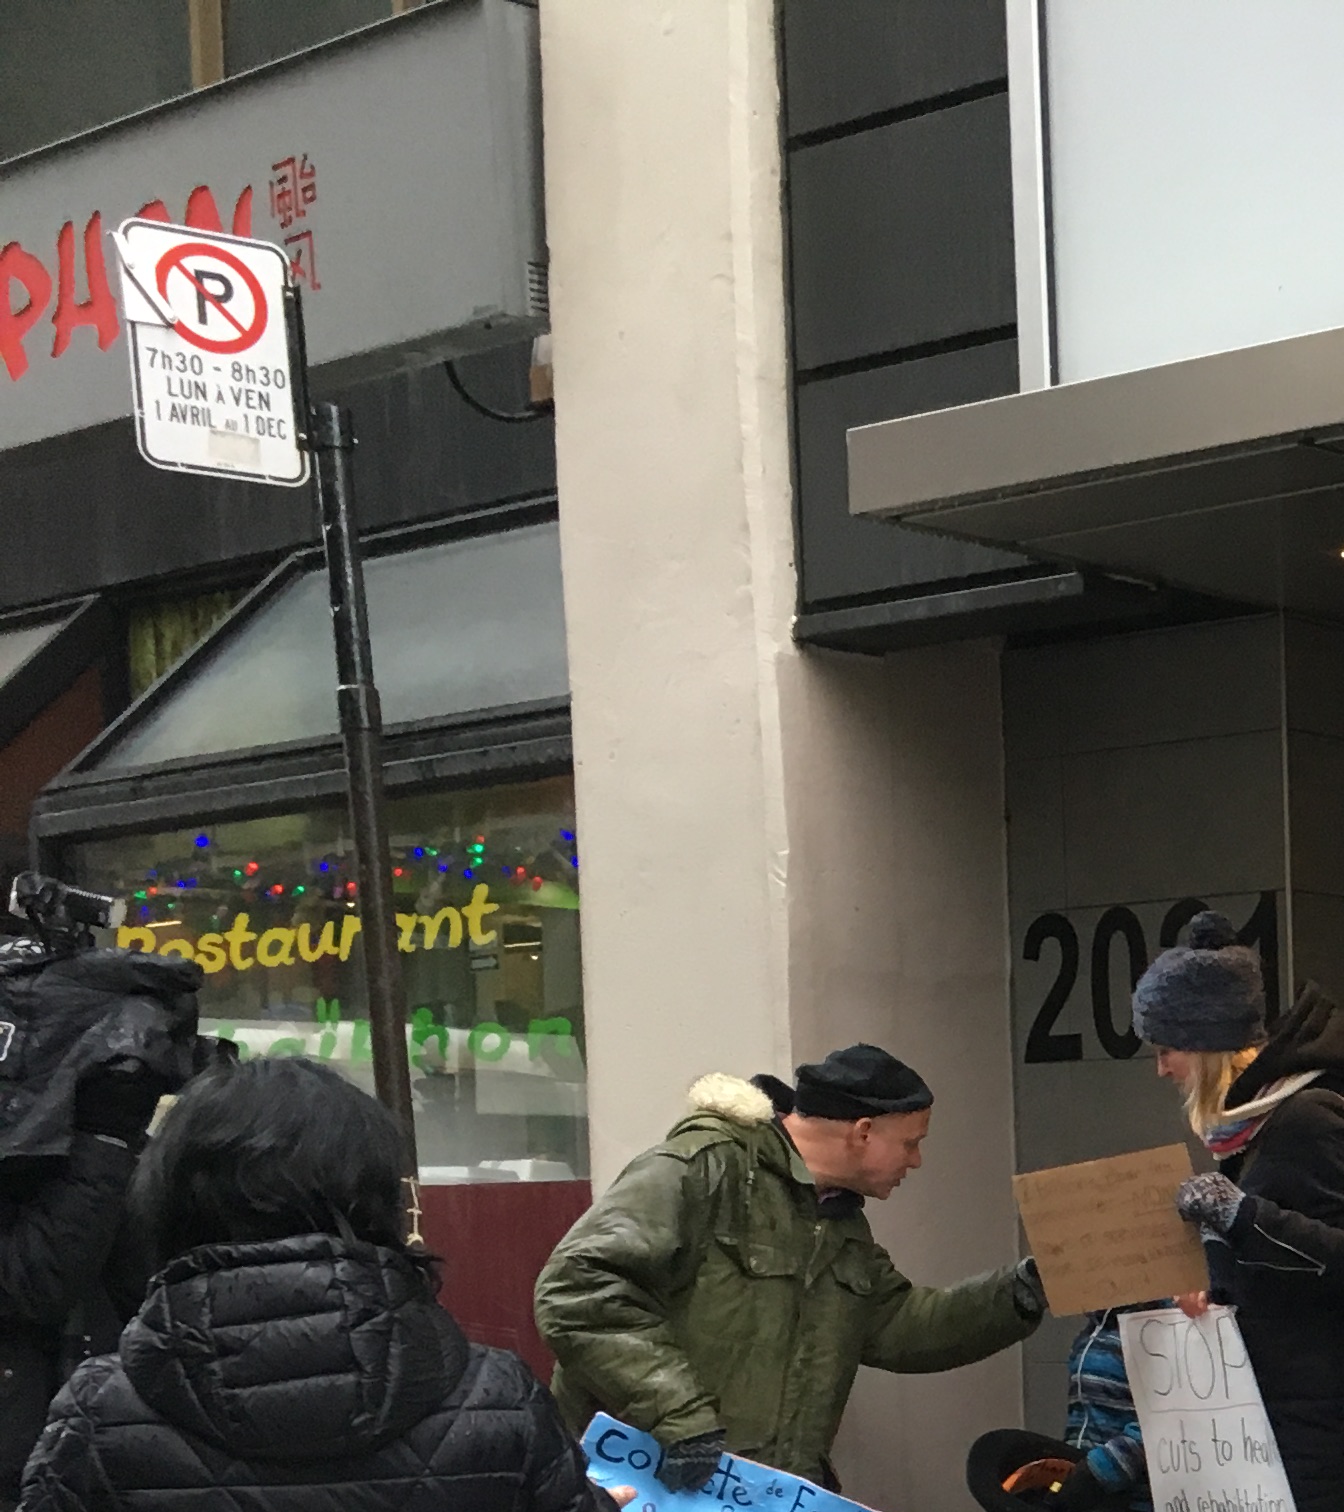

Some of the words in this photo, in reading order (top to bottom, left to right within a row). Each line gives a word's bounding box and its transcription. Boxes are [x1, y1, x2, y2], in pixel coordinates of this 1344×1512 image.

[145, 346, 203, 376] 7h30
[231, 361, 286, 390] 8h30
[167, 375, 208, 401] LUN
[230, 385, 271, 412] VEN
[155, 400, 162, 421] 1
[168, 400, 217, 429] AVRIL
[225, 419, 238, 431] AU
[243, 413, 249, 433] 1
[256, 415, 287, 440] DEC
[1140, 1315, 1248, 1400] STOP
[1157, 1419, 1201, 1474] cuts
[1212, 1418, 1233, 1466] to
[766, 1479, 783, 1498] de
